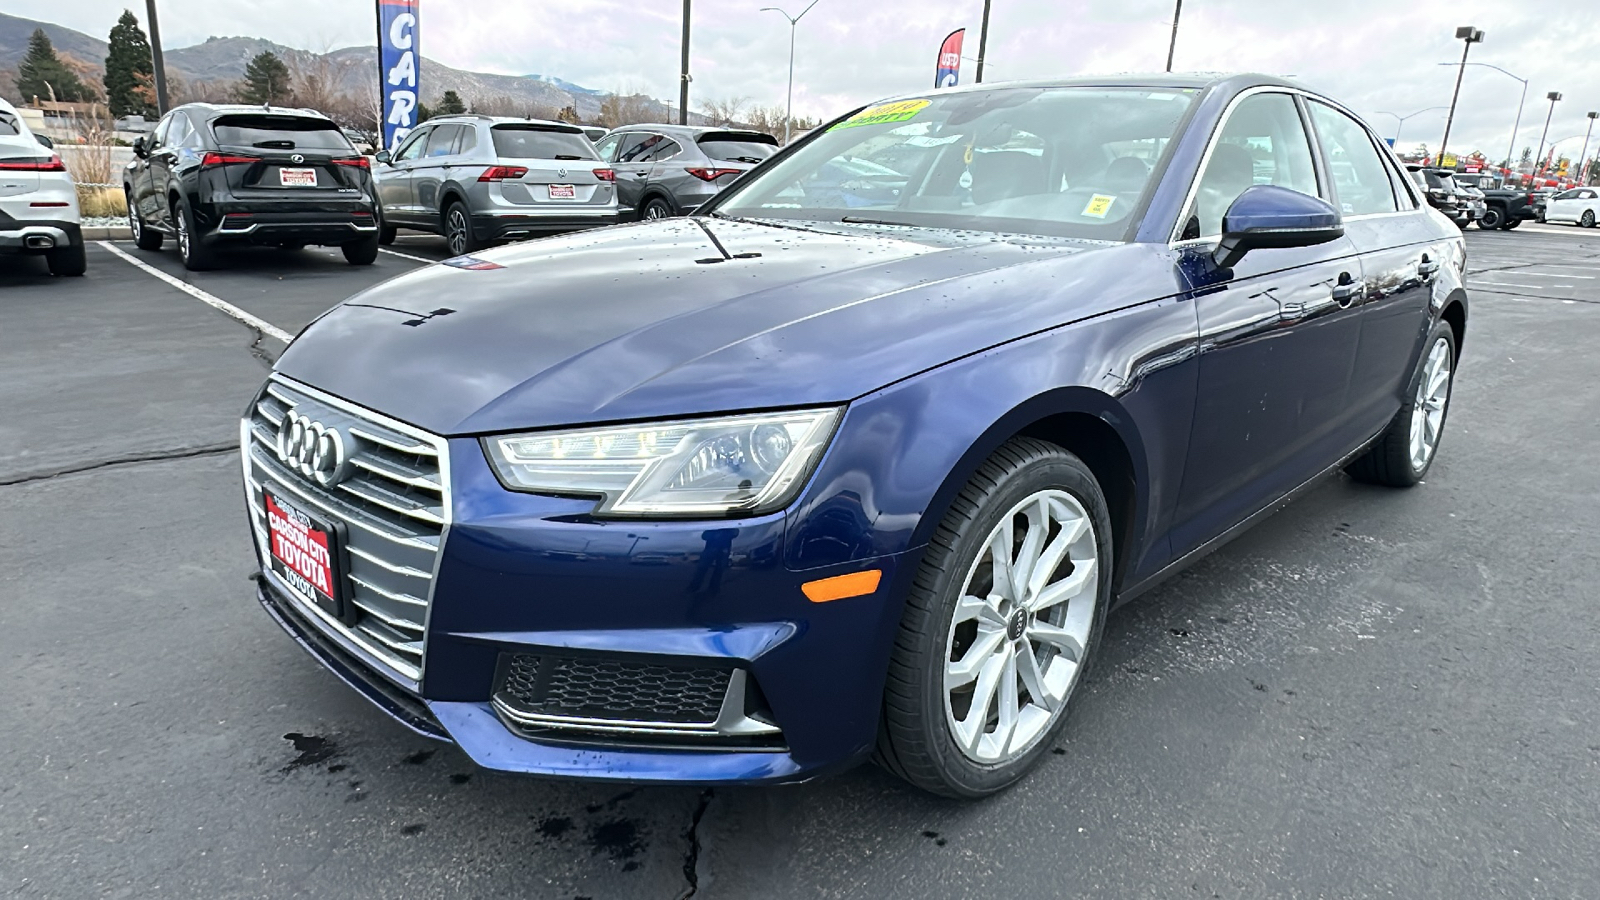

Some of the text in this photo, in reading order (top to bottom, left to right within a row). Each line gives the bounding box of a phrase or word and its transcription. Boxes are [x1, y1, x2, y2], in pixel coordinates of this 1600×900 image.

[268, 511, 309, 553] CARSON
[309, 538, 331, 569] CITY
[276, 534, 329, 592] TOYOTA
[283, 566, 318, 603] TOYOTA
